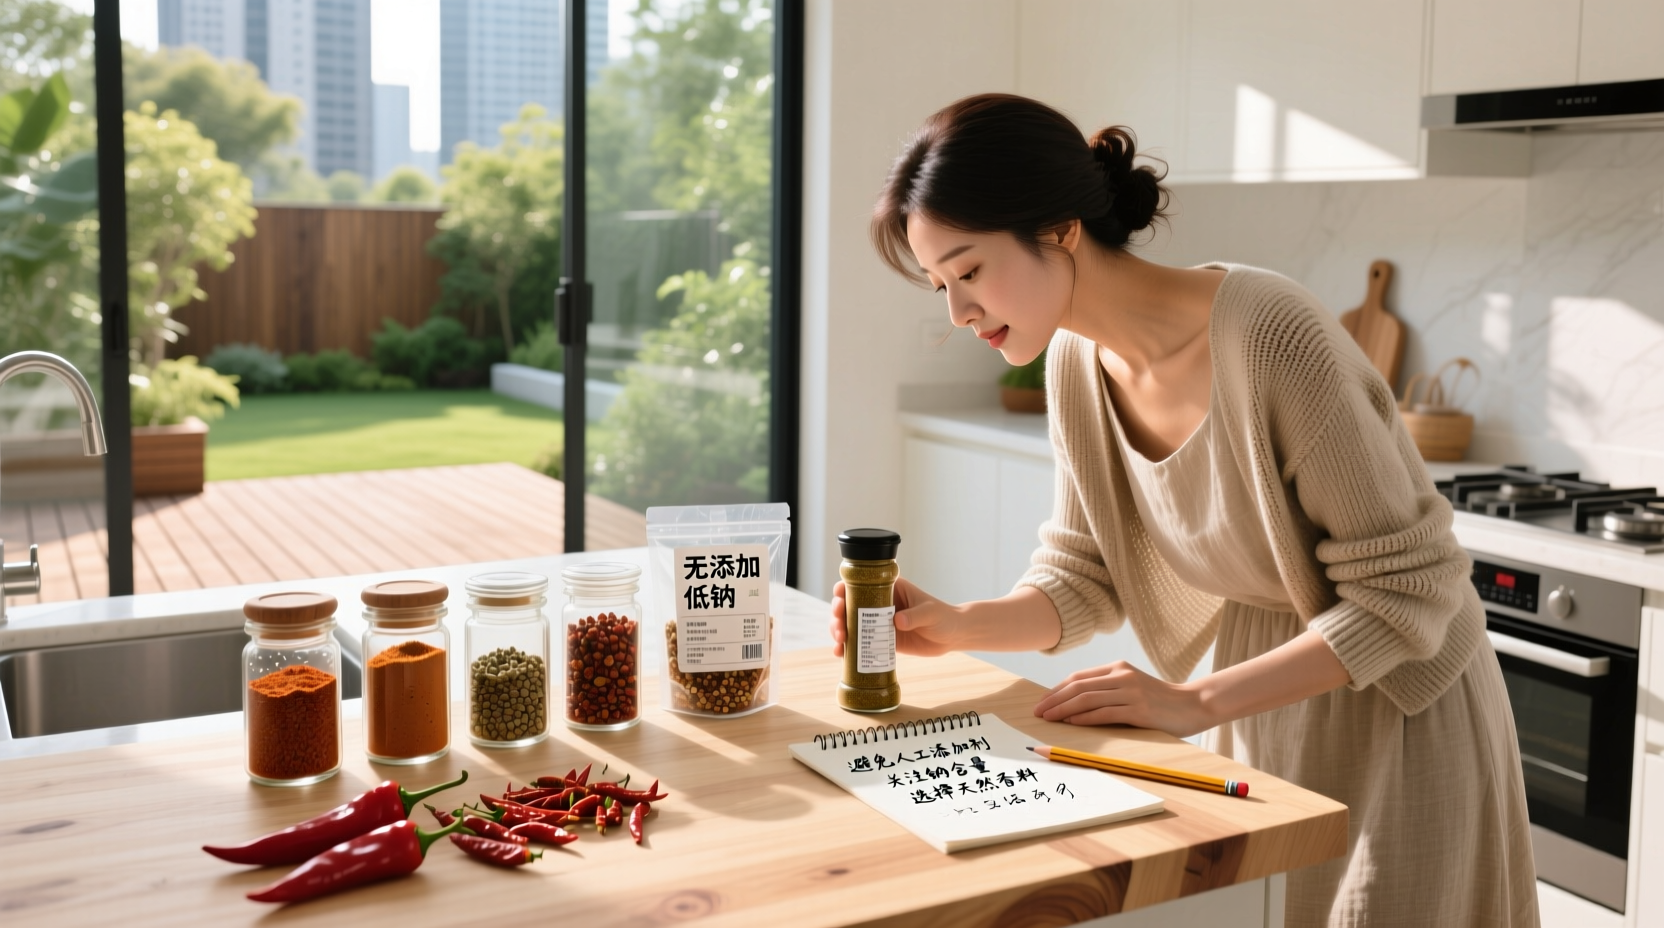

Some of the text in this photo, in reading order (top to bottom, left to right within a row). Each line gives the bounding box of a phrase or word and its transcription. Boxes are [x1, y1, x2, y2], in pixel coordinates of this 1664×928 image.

[683, 553, 760, 580] 无添加
[683, 584, 736, 610] 低钠
[910, 767, 1038, 804] 选择天然香料
